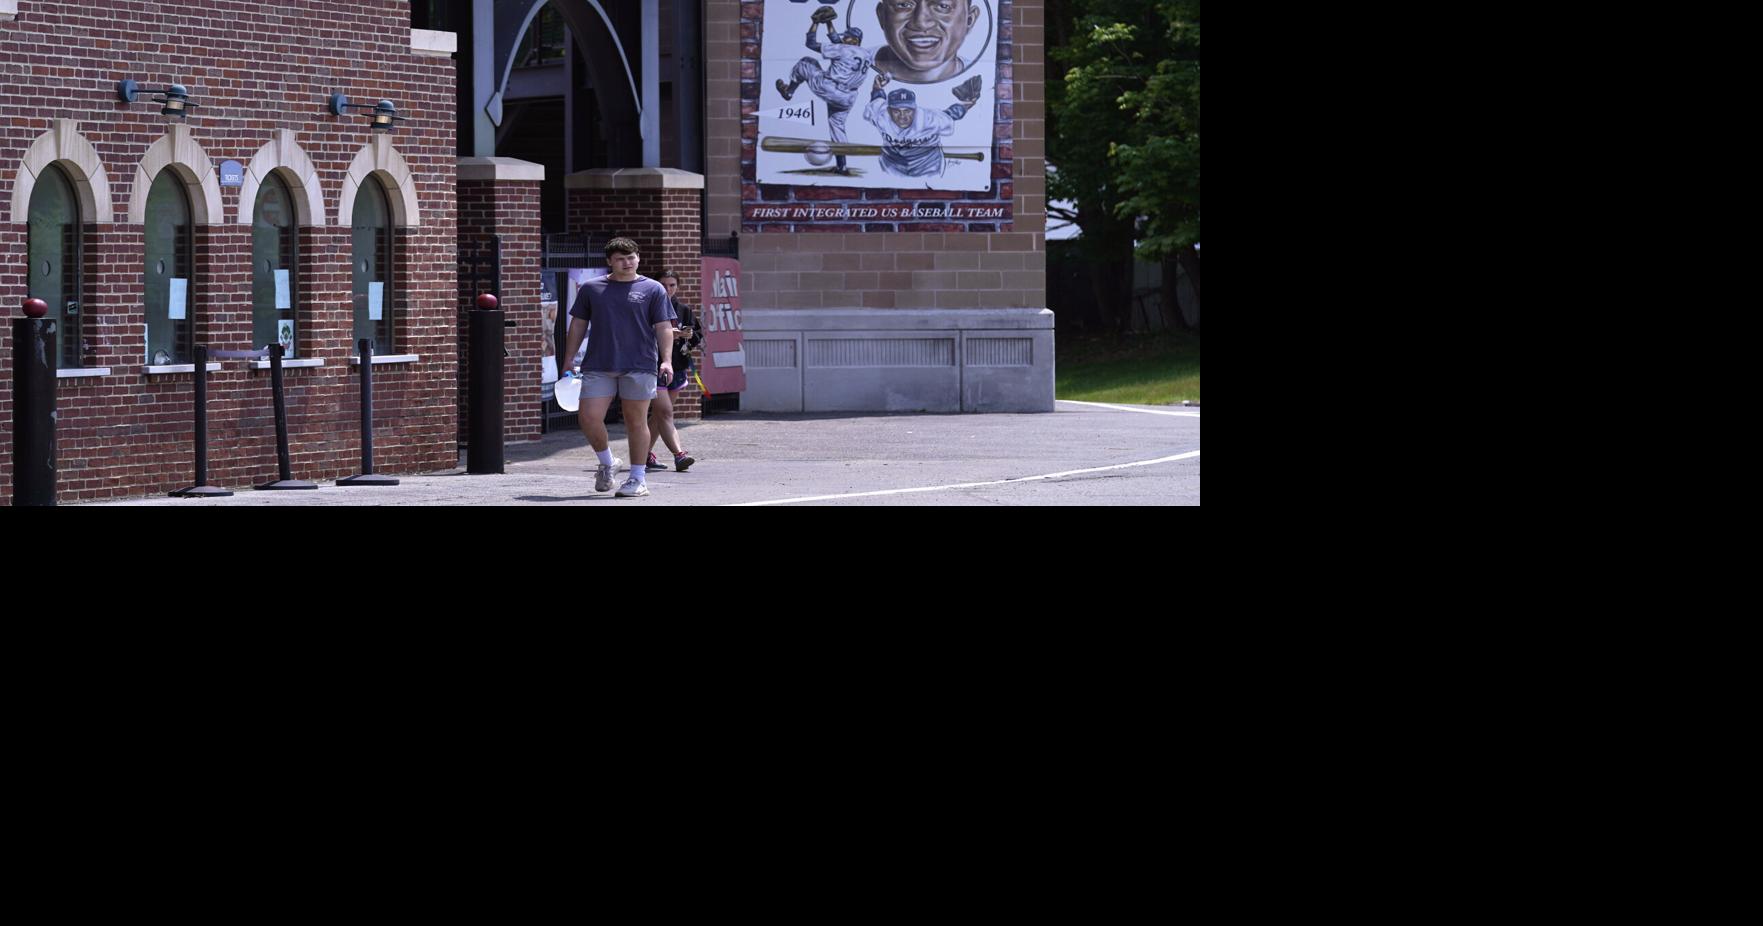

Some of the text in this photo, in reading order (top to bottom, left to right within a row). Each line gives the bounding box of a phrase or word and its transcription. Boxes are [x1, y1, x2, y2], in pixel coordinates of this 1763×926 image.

[778, 107, 811, 119] 1946
[752, 207, 1004, 218] FIRST INTEGRATED US BASEBALL TEAM
